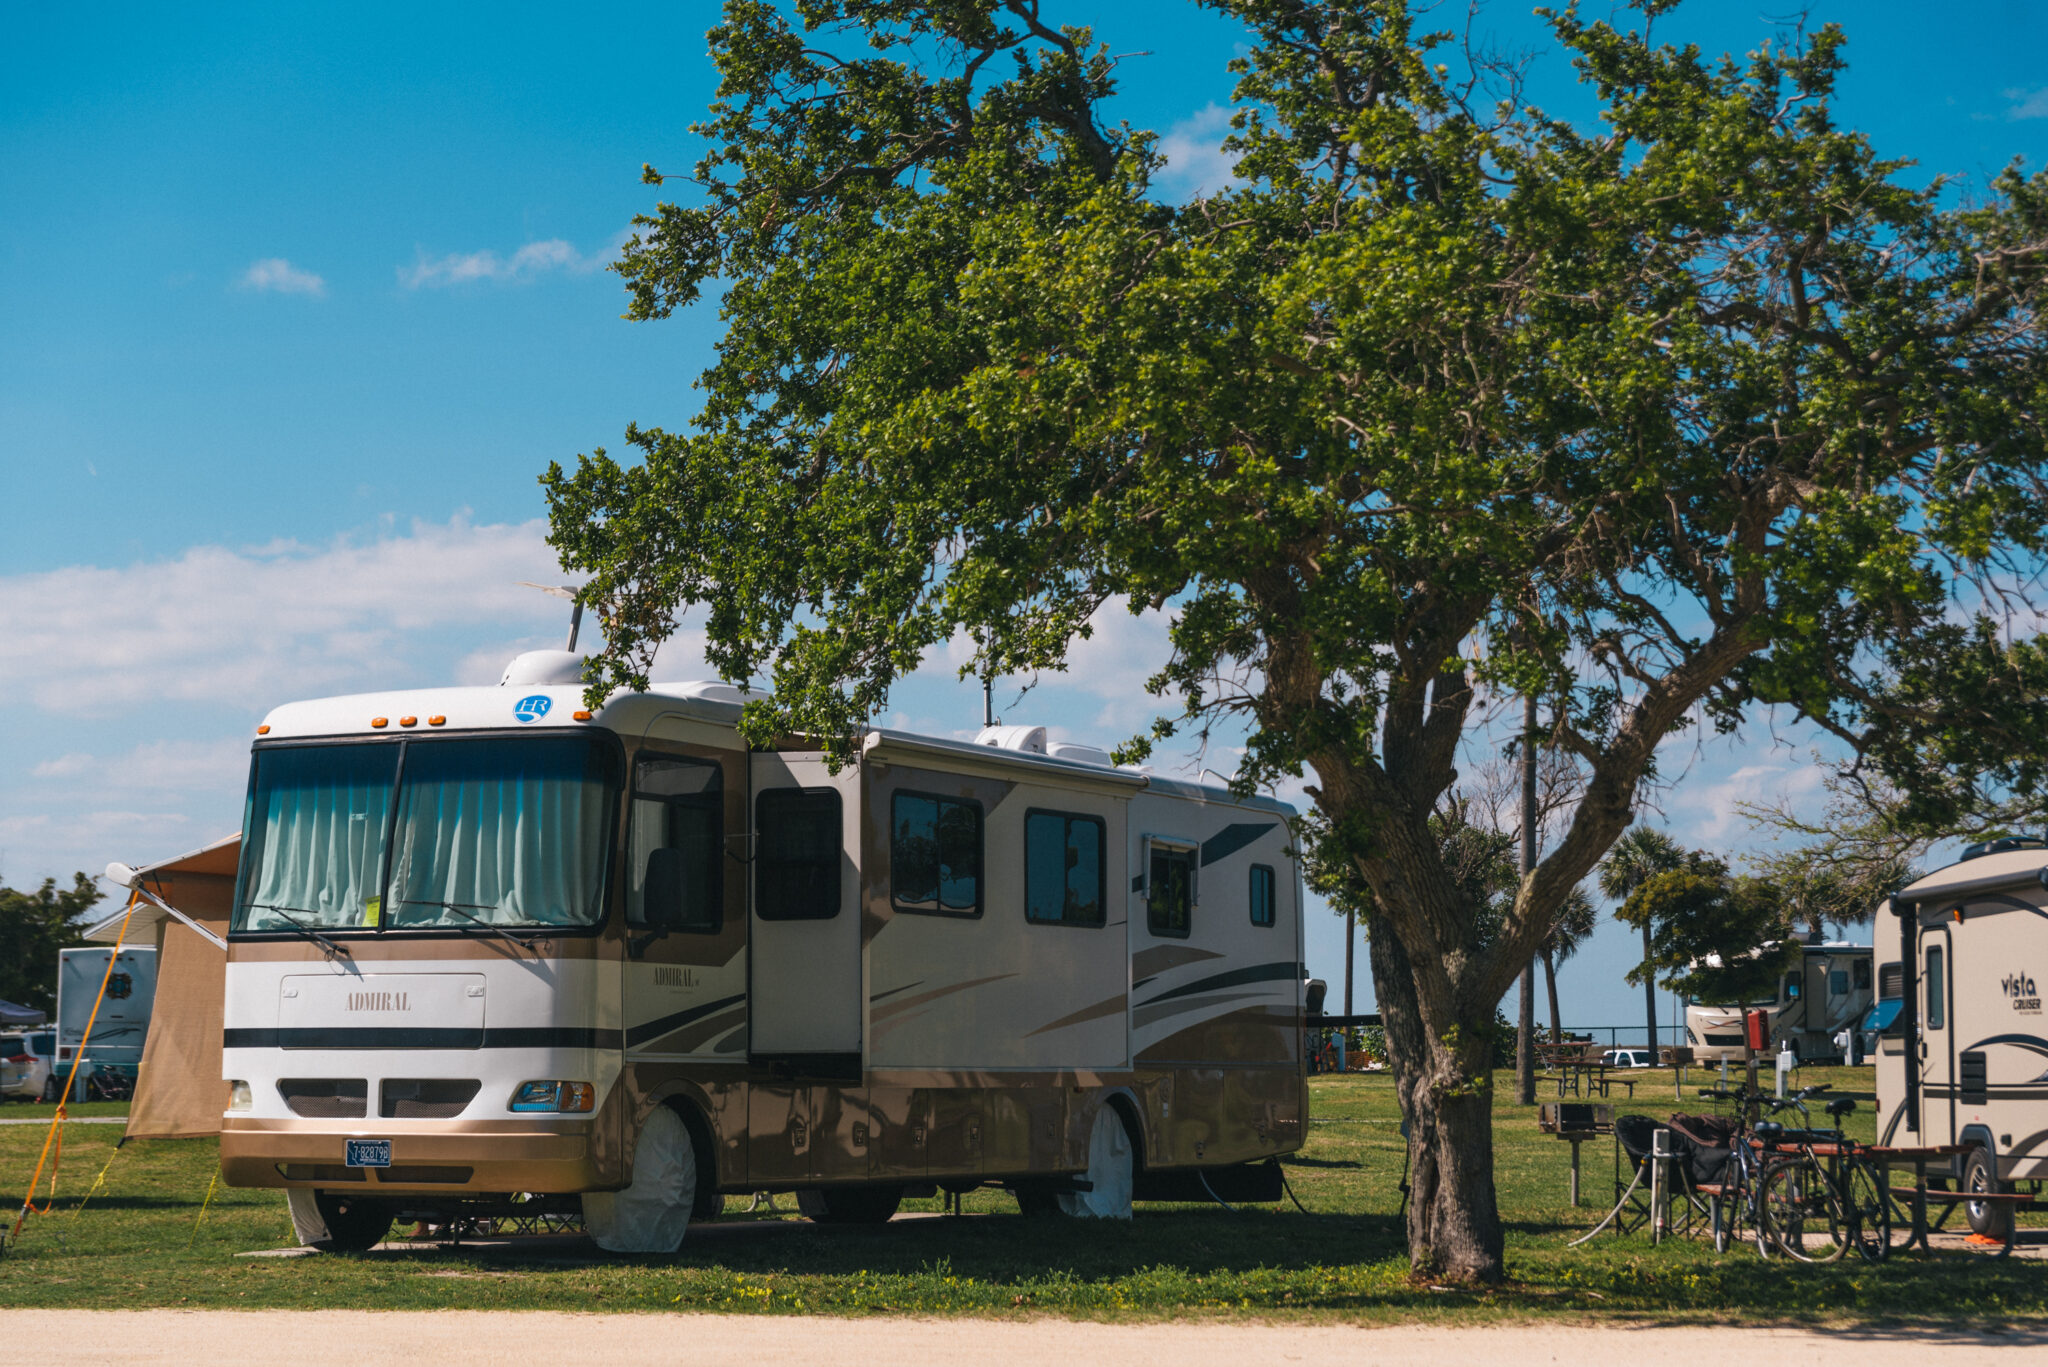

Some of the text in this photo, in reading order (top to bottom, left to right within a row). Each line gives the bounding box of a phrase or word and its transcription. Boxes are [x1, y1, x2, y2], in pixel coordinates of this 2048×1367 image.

[653, 968, 694, 987] ADMIRAL
[2001, 970, 2037, 997] vista
[345, 992, 411, 1011] ADMIRAL
[2013, 998, 2041, 1010] CRUISER
